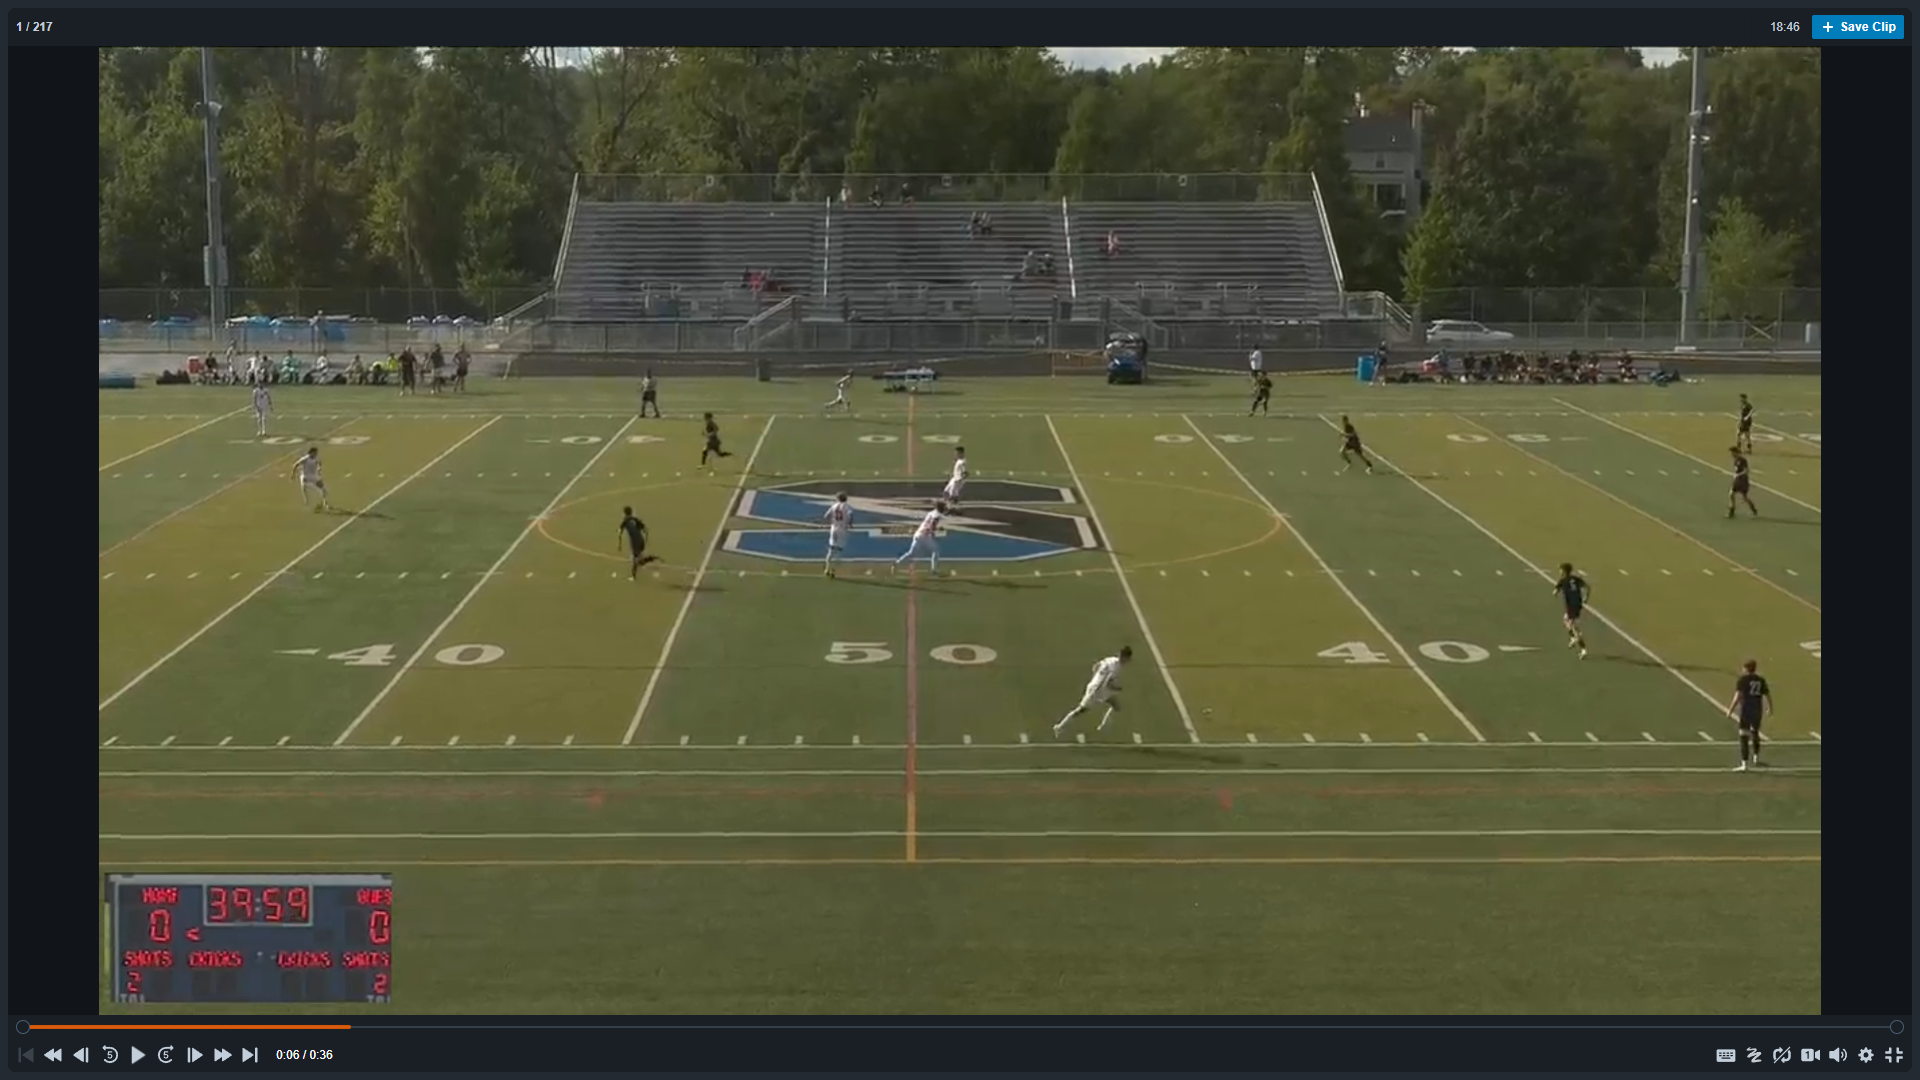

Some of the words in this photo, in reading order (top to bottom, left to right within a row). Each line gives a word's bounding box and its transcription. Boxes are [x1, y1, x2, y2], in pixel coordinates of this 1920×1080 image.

[327, 643, 505, 666] 40
[824, 641, 998, 664] 50
[1317, 640, 1491, 663] 40
[208, 886, 311, 923] 39:59
[149, 908, 172, 943] 0
[368, 909, 391, 944] 0
[123, 950, 174, 968] SHOTS
[126, 971, 143, 993] 2
[373, 972, 390, 994] 2
